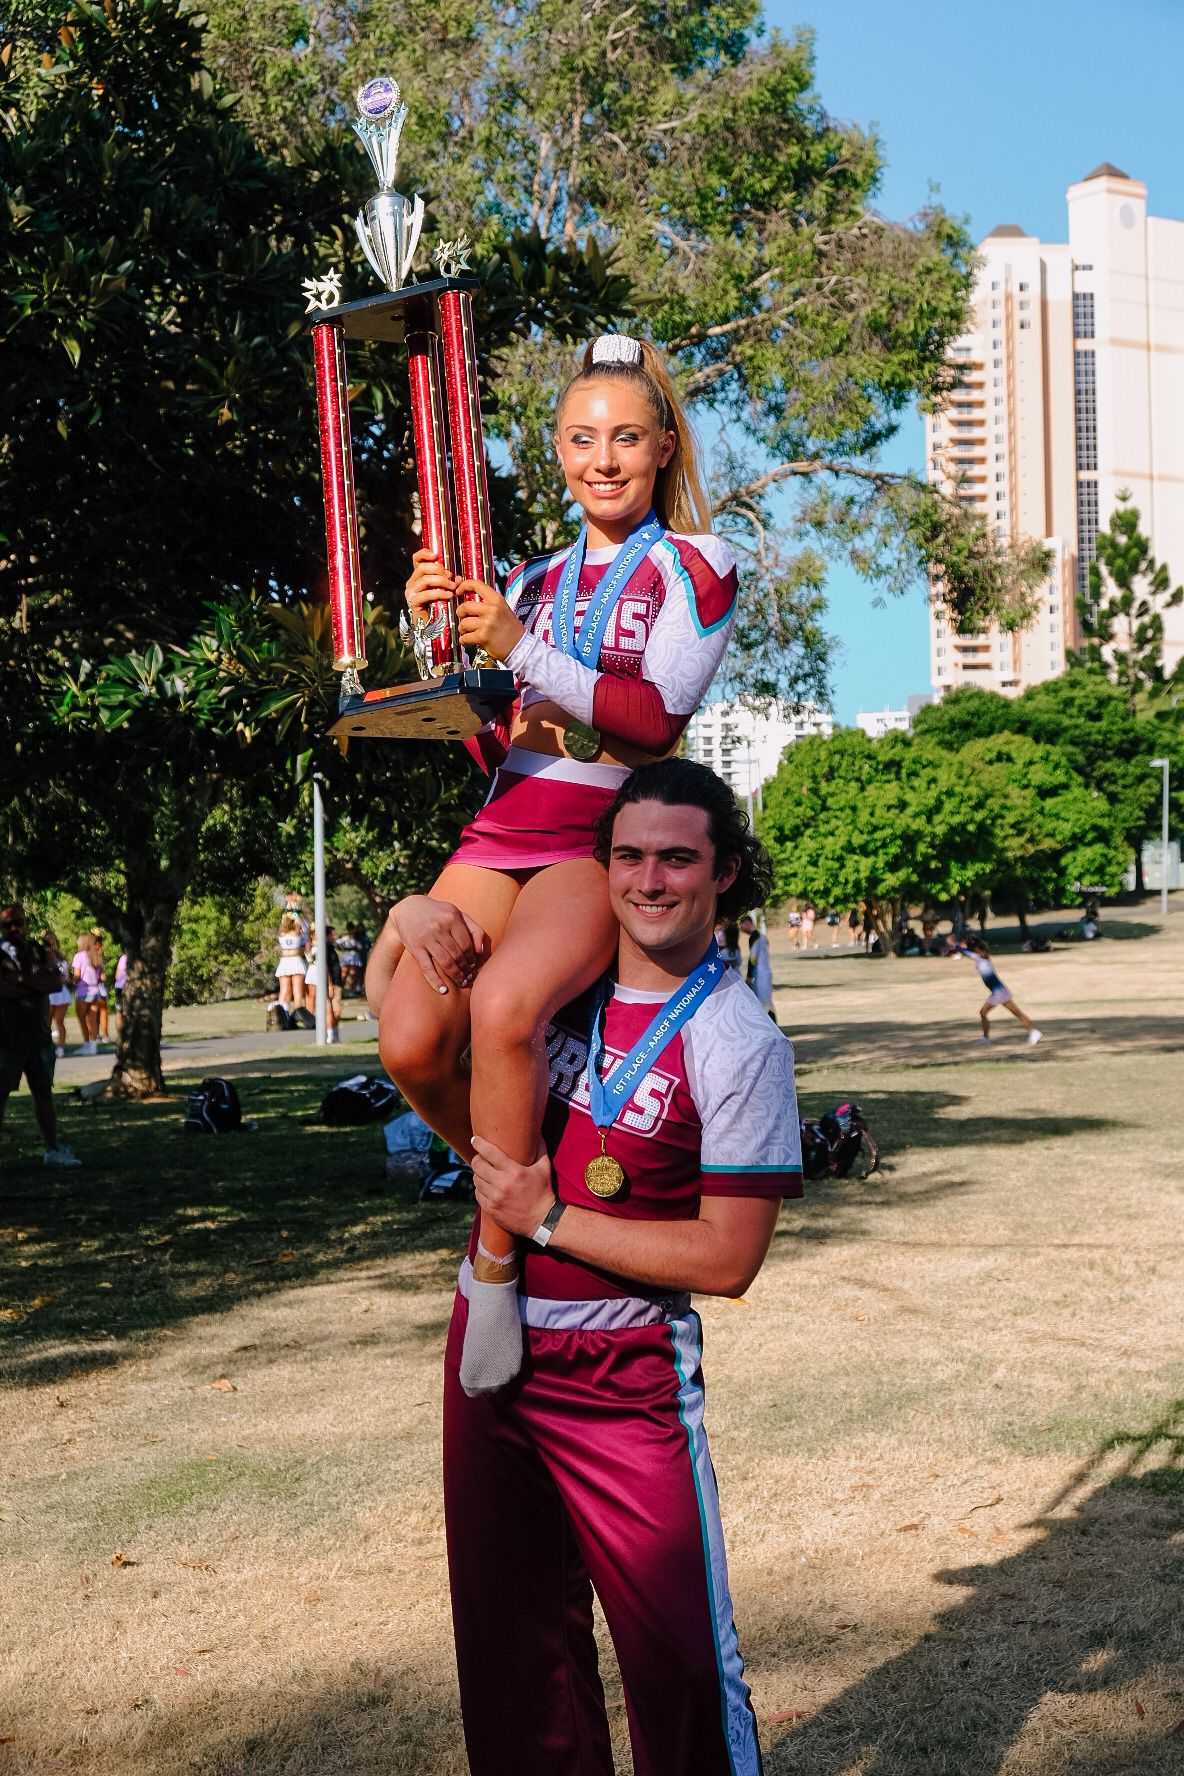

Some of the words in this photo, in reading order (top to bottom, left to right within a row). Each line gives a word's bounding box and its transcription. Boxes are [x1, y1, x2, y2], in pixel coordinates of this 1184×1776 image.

[581, 640, 593, 657] 1ST
[587, 608, 603, 640] PLACE
[600, 579, 619, 604] AASCF
[614, 542, 643, 579] NATIONALS
[613, 1079, 628, 1096] 1ST
[624, 1051, 648, 1080] PLACE
[648, 1019, 672, 1049] AASCF
[668, 977, 706, 1021] NATIONALS
